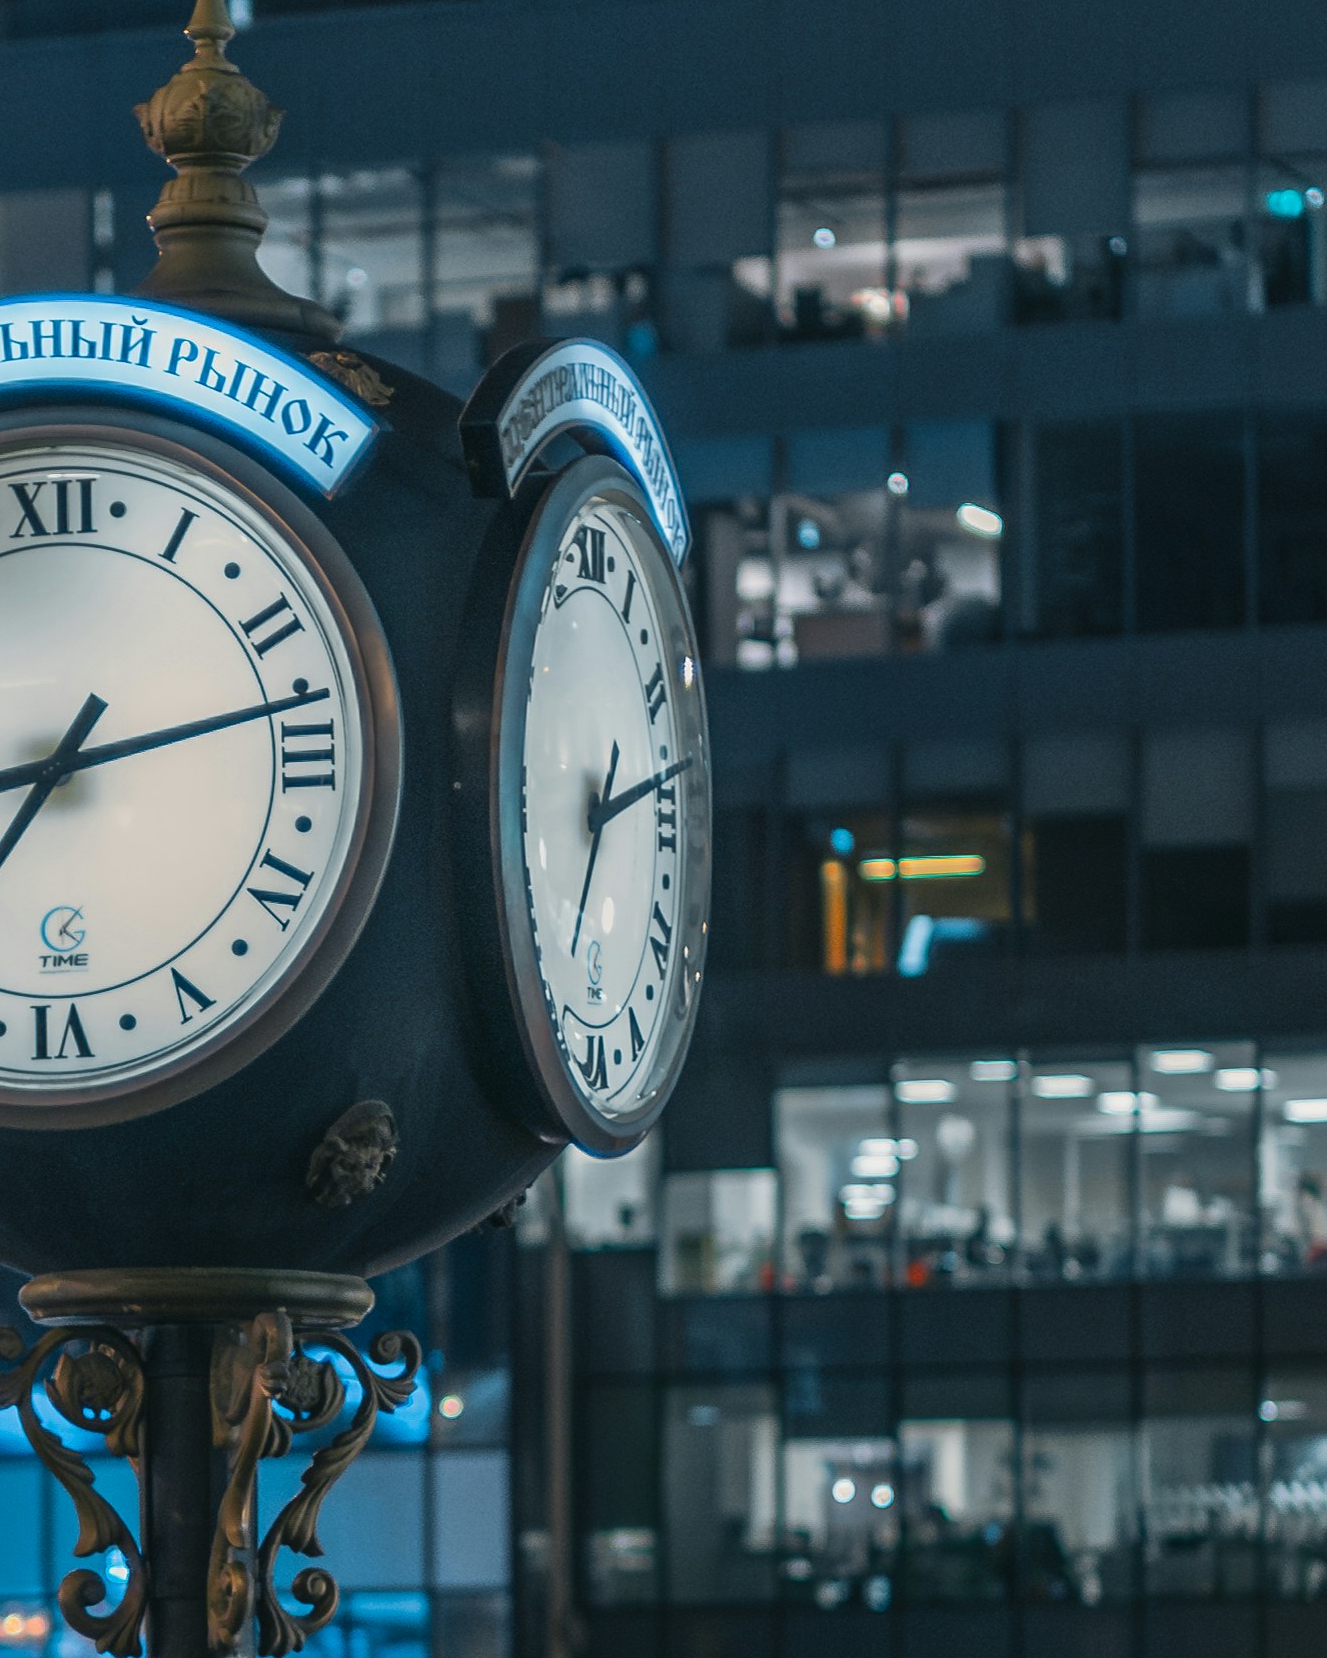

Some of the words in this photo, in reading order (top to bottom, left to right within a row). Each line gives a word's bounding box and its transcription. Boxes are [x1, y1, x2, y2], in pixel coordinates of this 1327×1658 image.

[163, 337, 350, 469] РЫНОК
[8, 477, 98, 539] XII
[158, 506, 201, 565] I
[238, 591, 306, 661] II
[645, 662, 667, 725] II
[281, 718, 336, 794] III
[246, 847, 315, 932] IV
[38, 953, 90, 968] TIME
[170, 966, 218, 1026] V
[29, 1002, 96, 1061] VI
[628, 1006, 646, 1063] V
